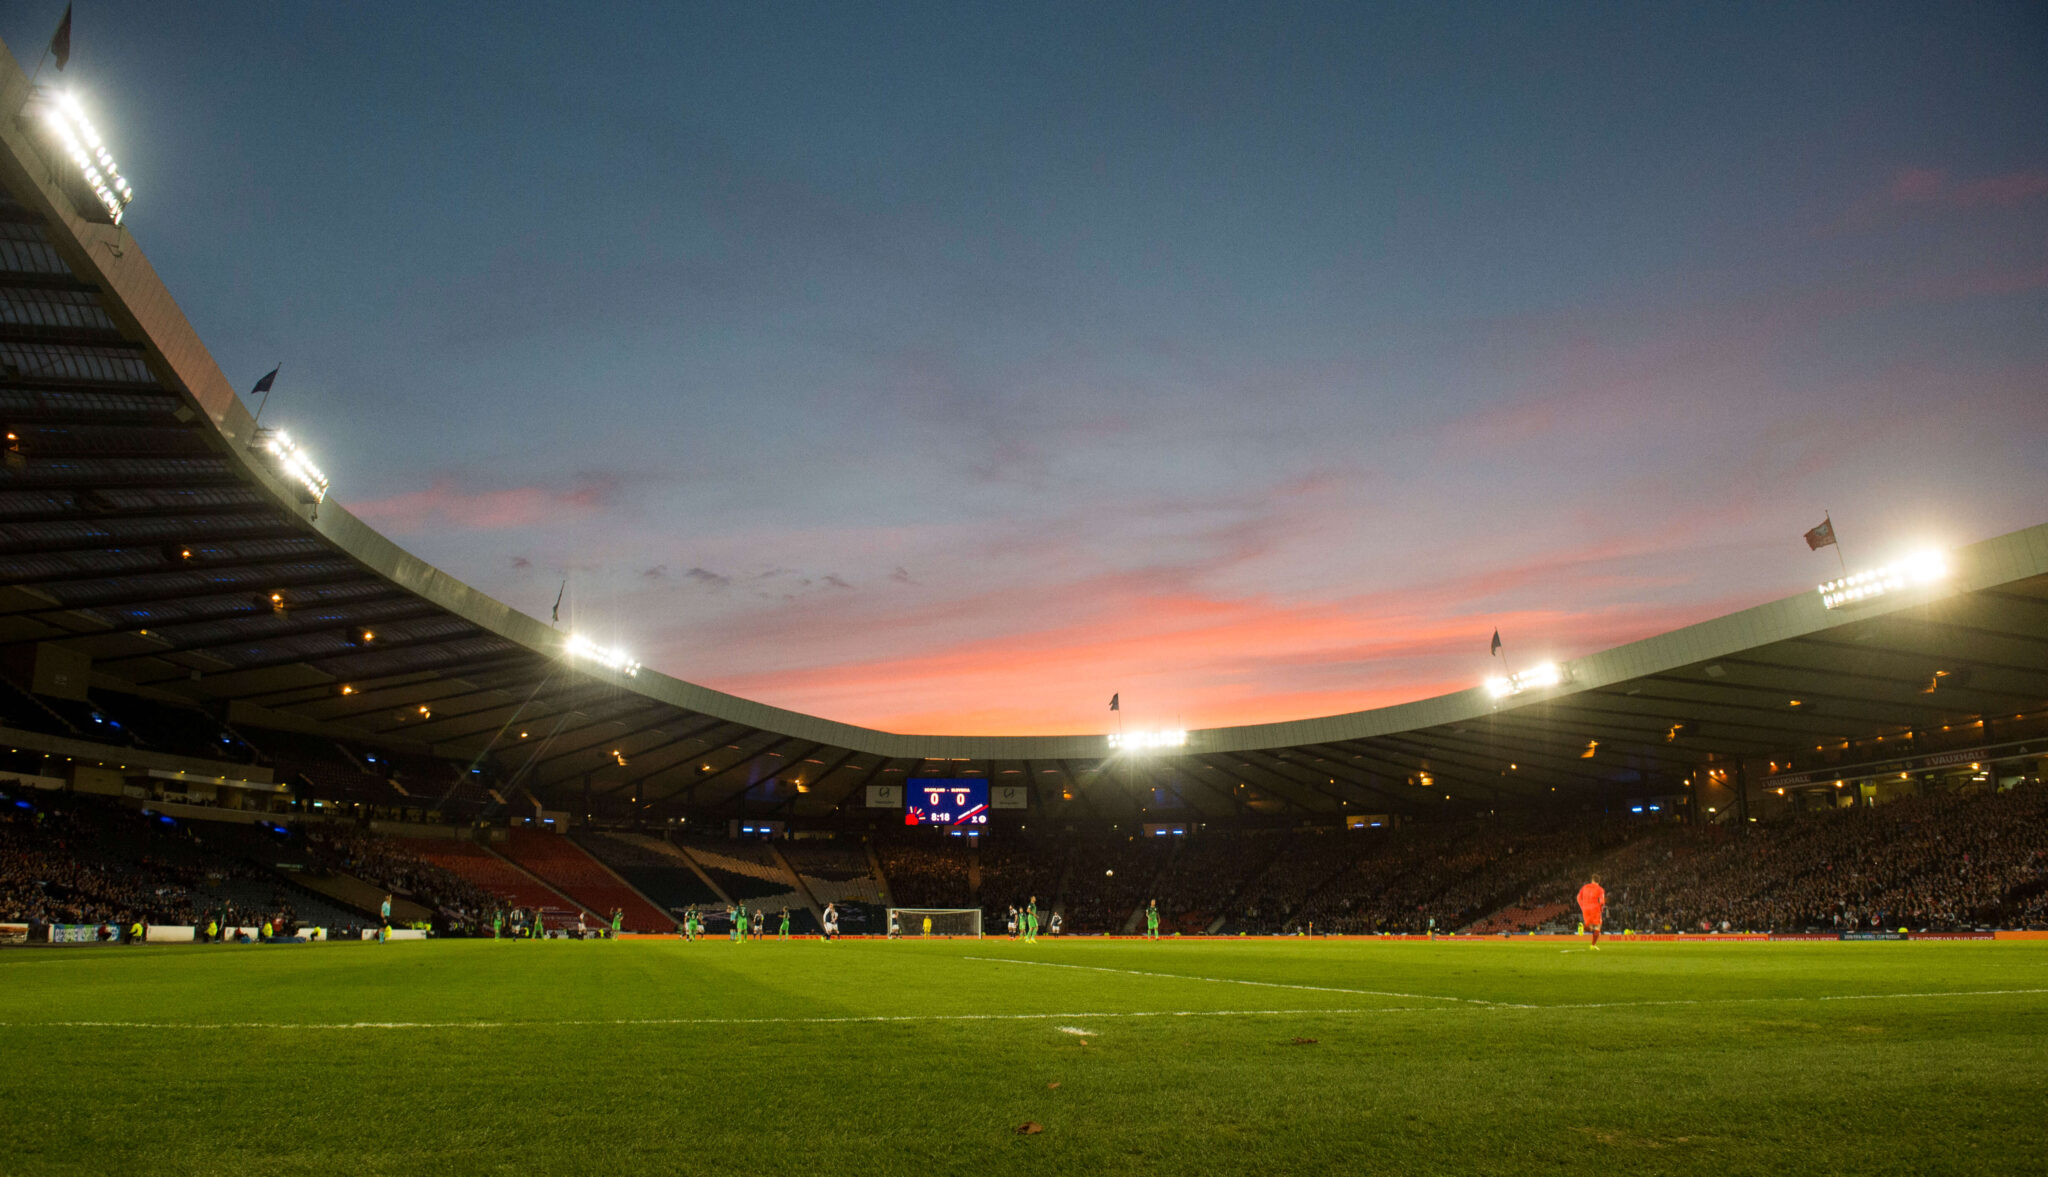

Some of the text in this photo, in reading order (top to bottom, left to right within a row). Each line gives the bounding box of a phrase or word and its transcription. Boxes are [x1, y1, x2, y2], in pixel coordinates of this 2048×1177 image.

[1931, 751, 1988, 764] VAUXHALL
[1767, 776, 1810, 786] VAUXHALL
[930, 793, 965, 806] 0 0
[931, 812, 950, 822] 8:18
